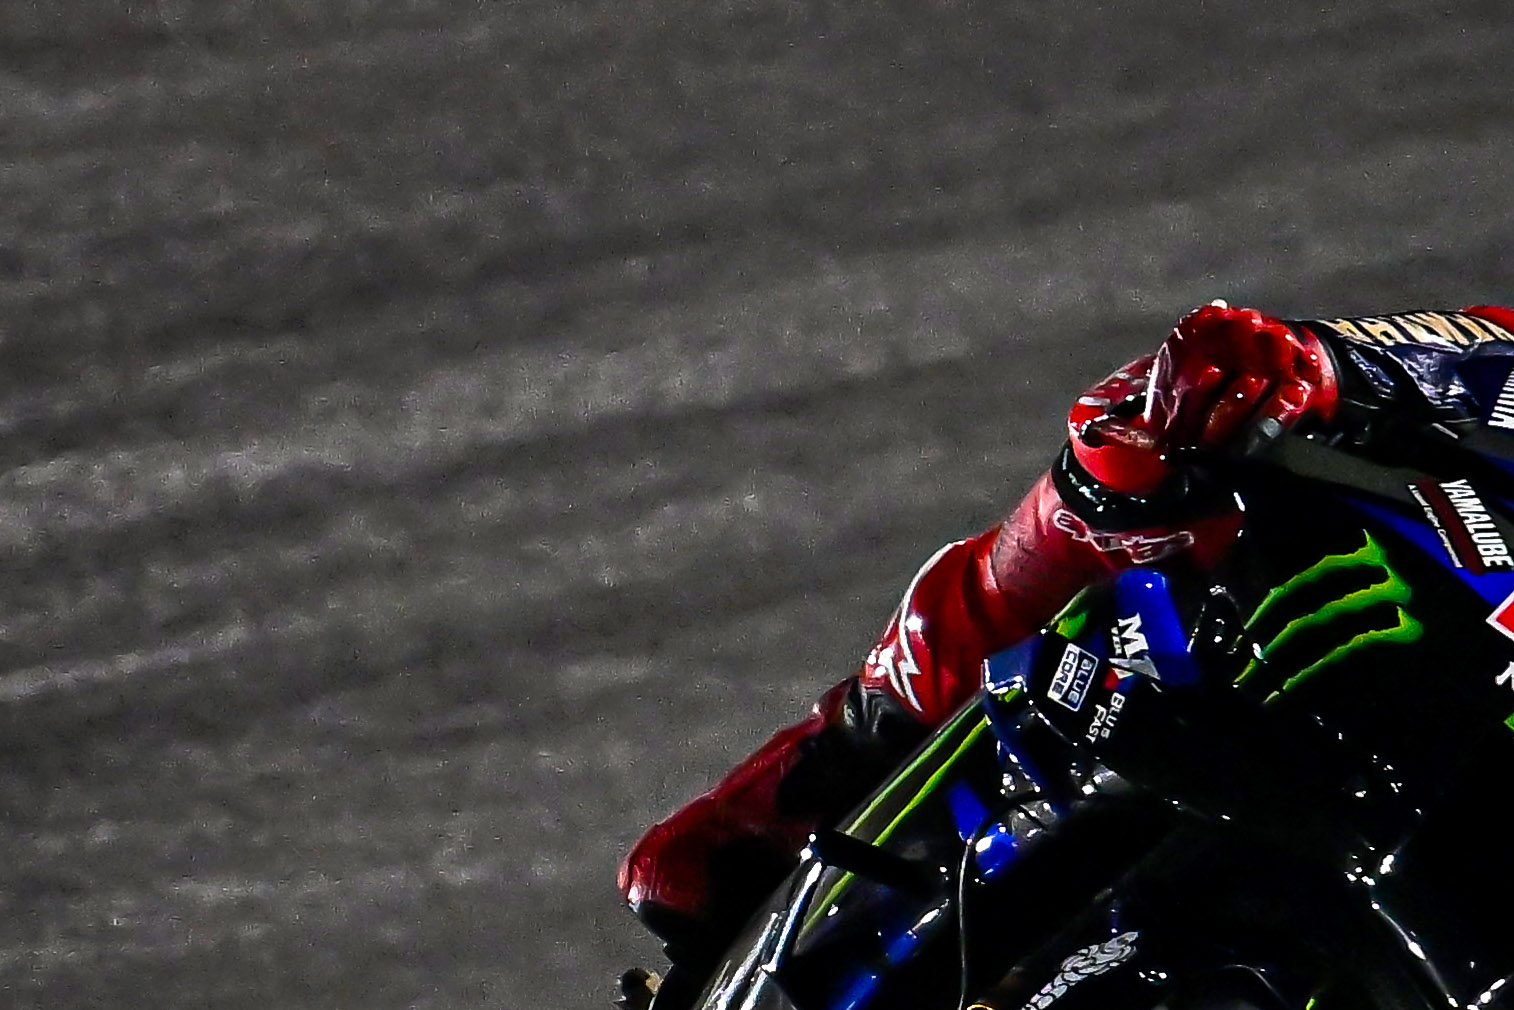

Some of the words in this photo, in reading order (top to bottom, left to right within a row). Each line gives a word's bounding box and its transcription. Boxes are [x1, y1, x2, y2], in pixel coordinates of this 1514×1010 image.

[1438, 478, 1514, 568] YAMALUBE
[1051, 650, 1078, 695] CORE
[1067, 658, 1094, 704] BLUE
[1085, 704, 1107, 744] FAST
